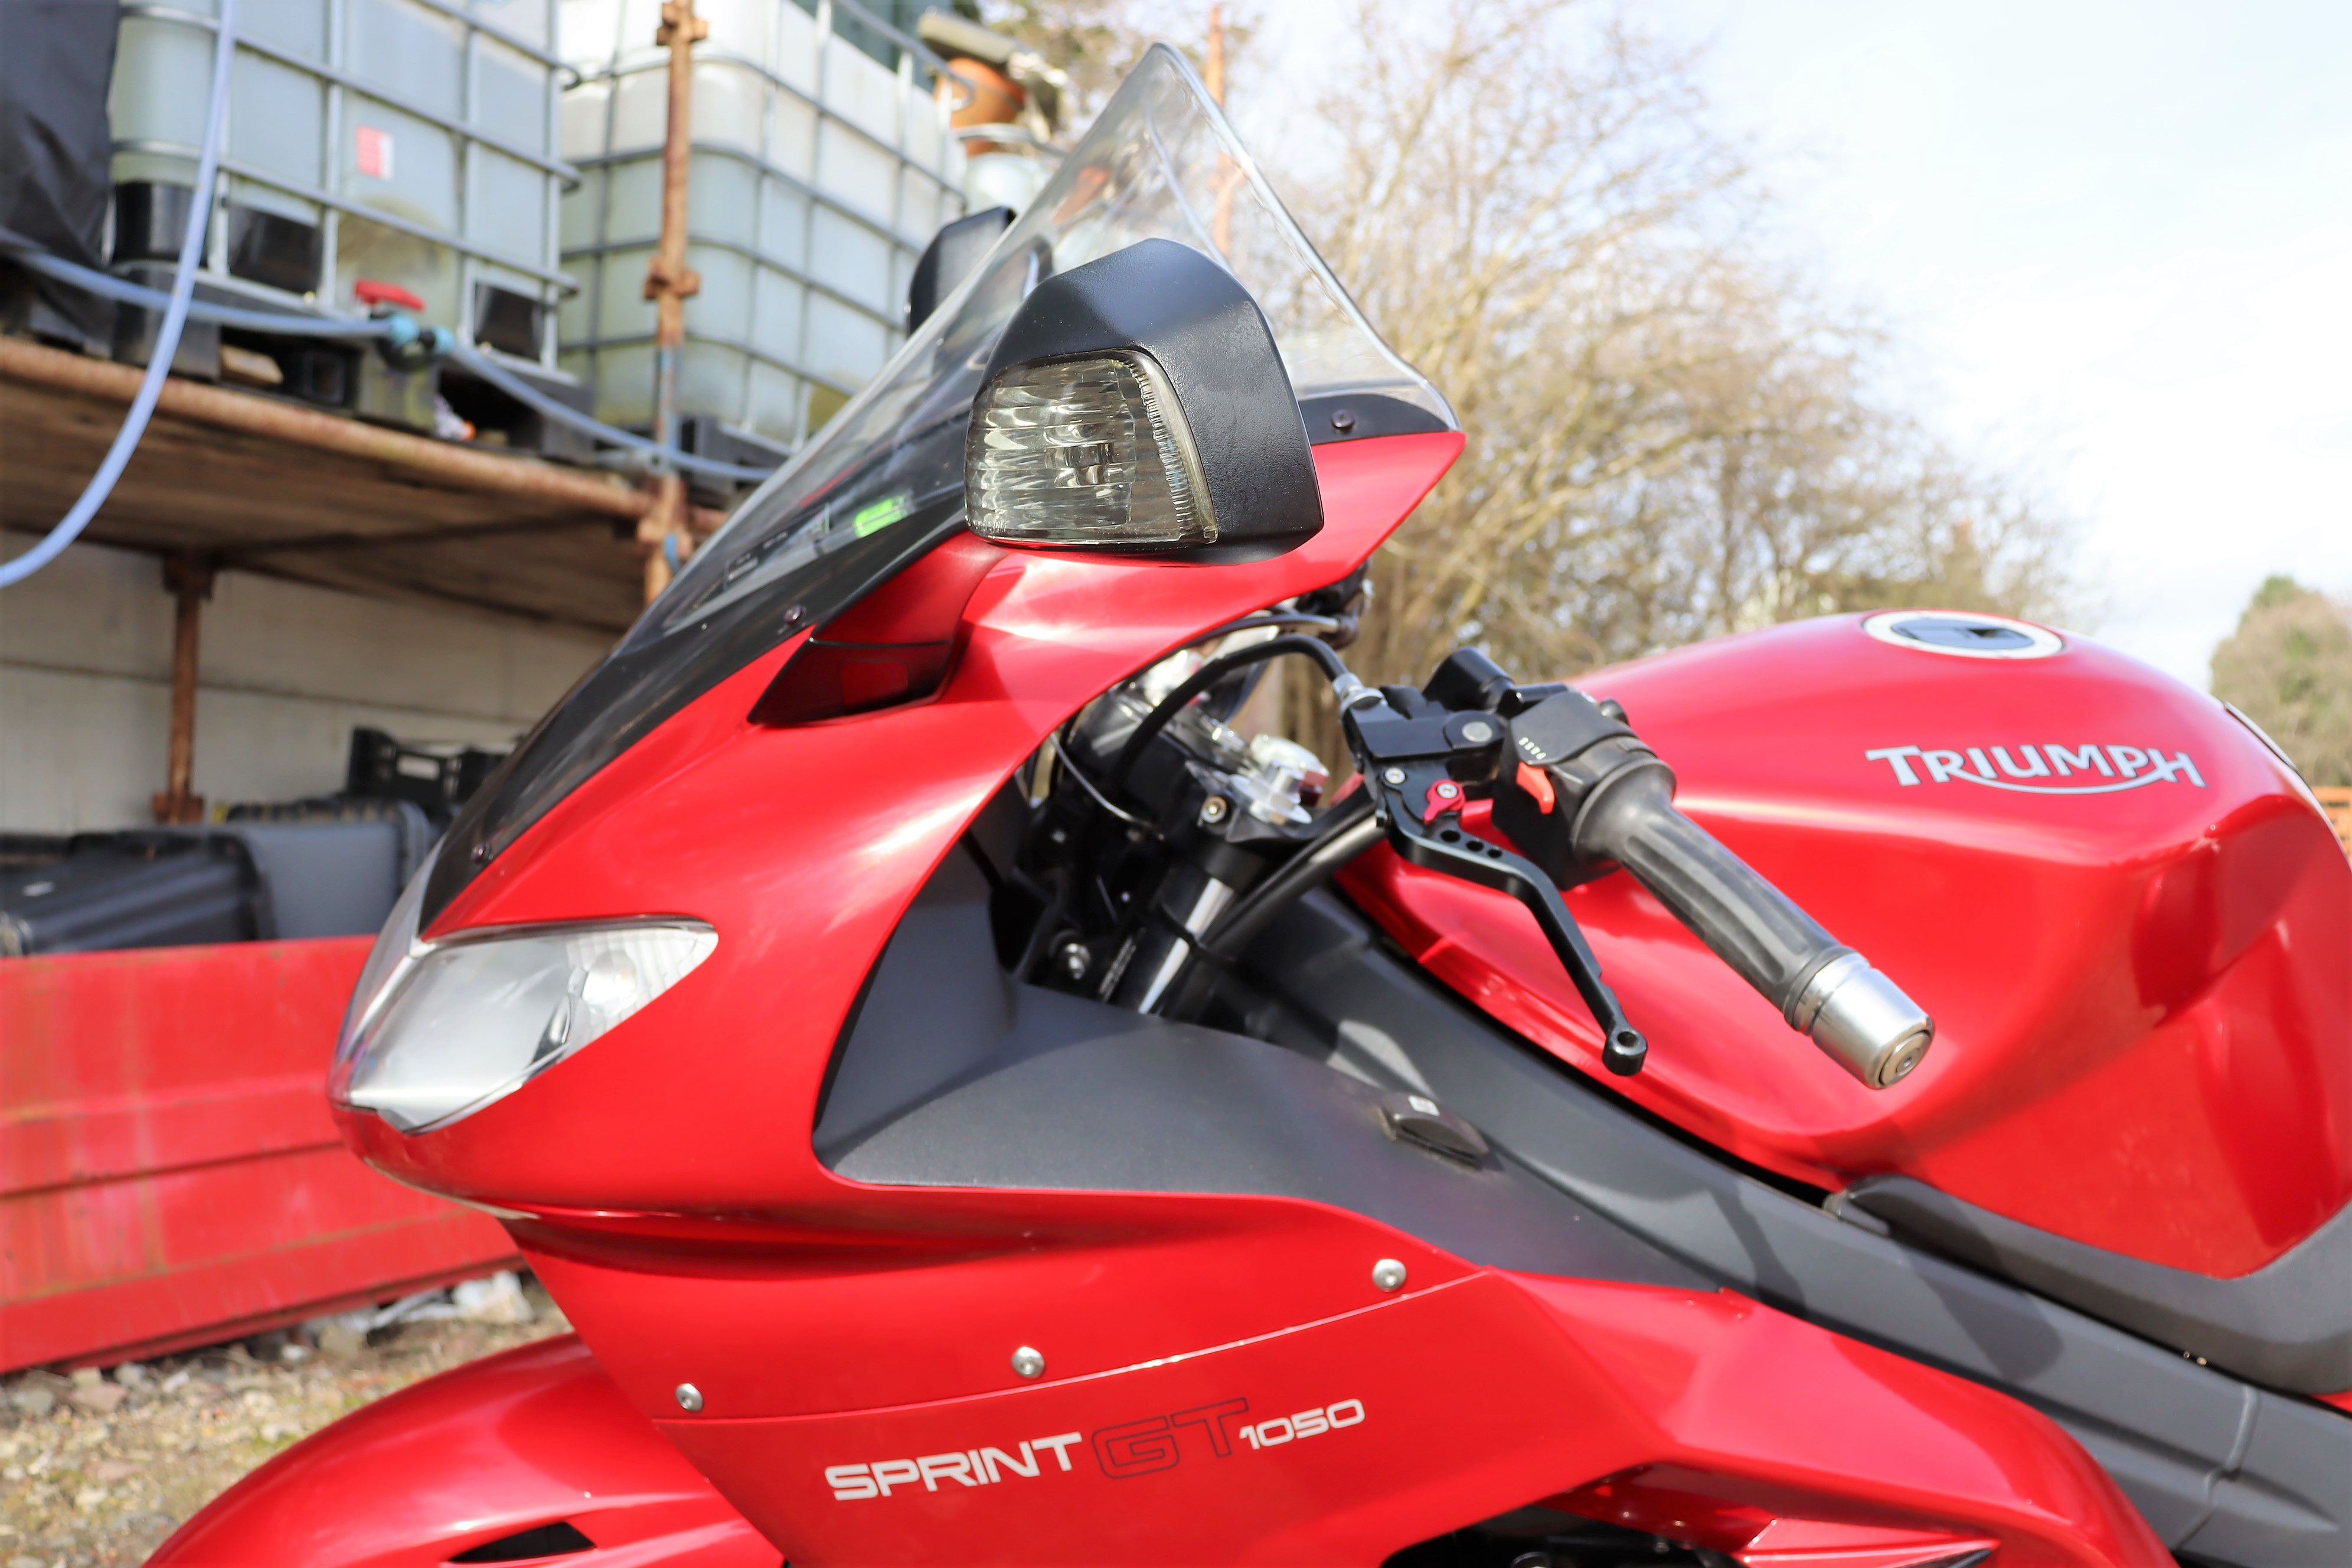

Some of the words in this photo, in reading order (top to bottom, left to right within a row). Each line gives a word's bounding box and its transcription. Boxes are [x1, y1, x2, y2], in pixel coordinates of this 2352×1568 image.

[1864, 744, 2207, 795] TRIUMPH
[825, 1432, 1082, 1501] SPRINT
[1092, 1397, 1249, 1479] GT
[1239, 1399, 1366, 1450] 1050
